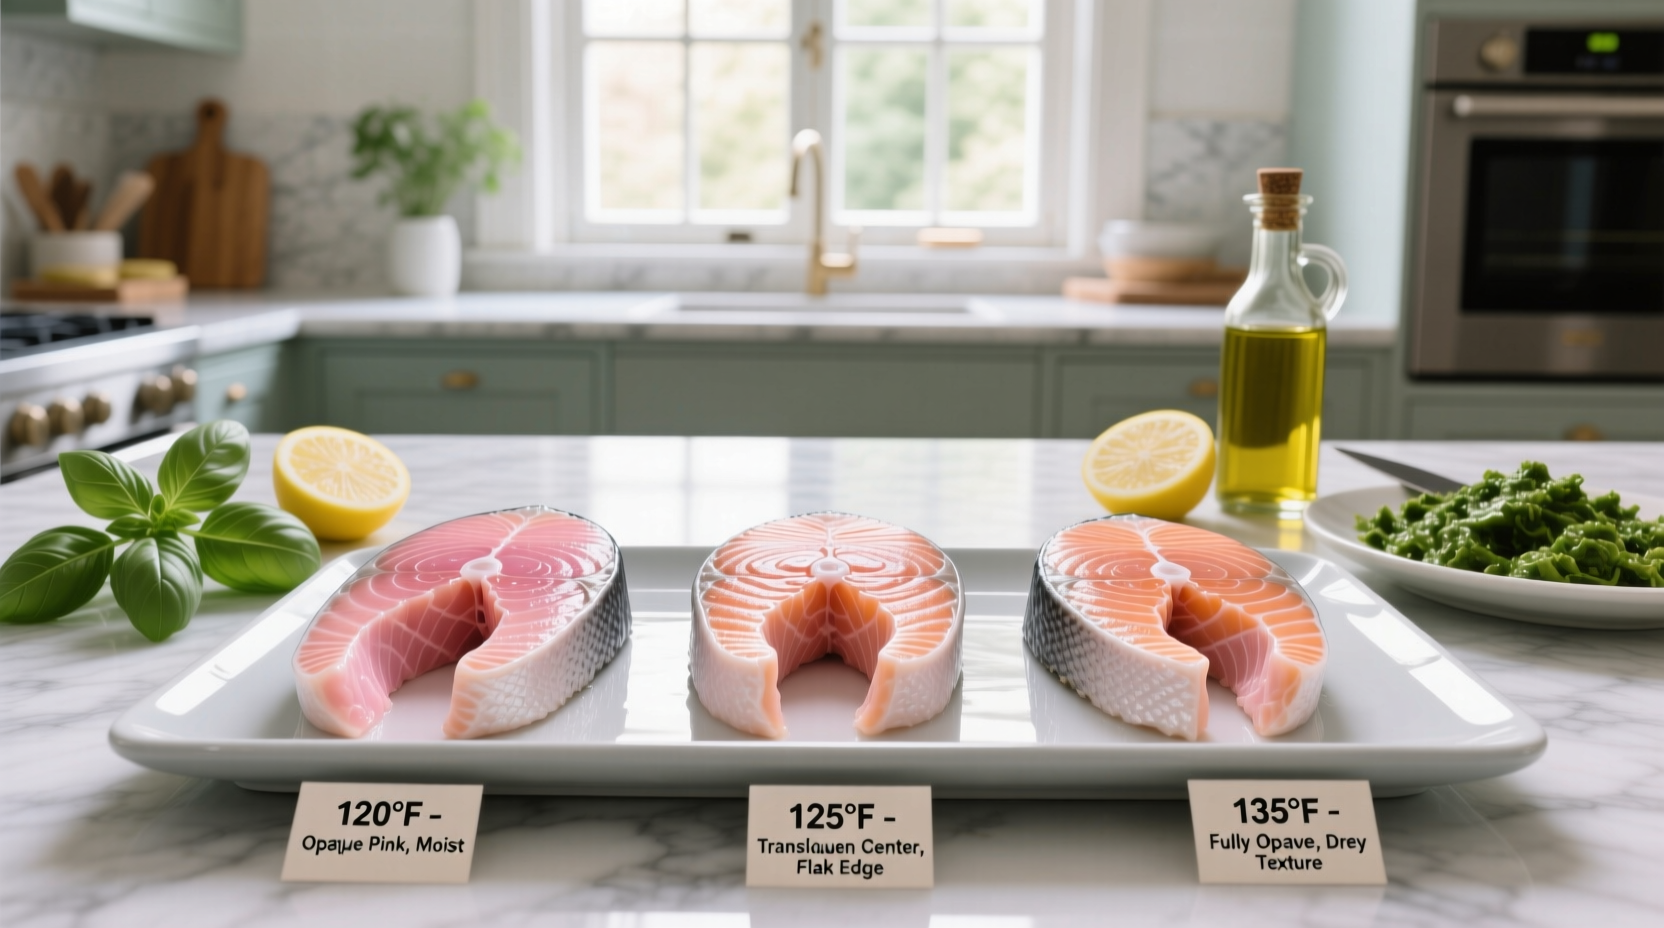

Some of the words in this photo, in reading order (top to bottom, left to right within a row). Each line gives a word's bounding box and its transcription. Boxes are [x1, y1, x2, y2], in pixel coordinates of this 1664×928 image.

[337, 800, 424, 827] 120°F
[789, 802, 876, 830] 125°F
[1232, 797, 1319, 825] 135°F
[368, 835, 410, 856] Pink,
[415, 835, 465, 854] Moist
[861, 838, 925, 858] Center,
[1209, 832, 1251, 854] Fully
[1255, 832, 1321, 854] Opave,
[1325, 833, 1367, 854] Drey
[796, 858, 834, 876] Flak
[839, 858, 884, 881] Edge
[1254, 854, 1323, 871] Texture
